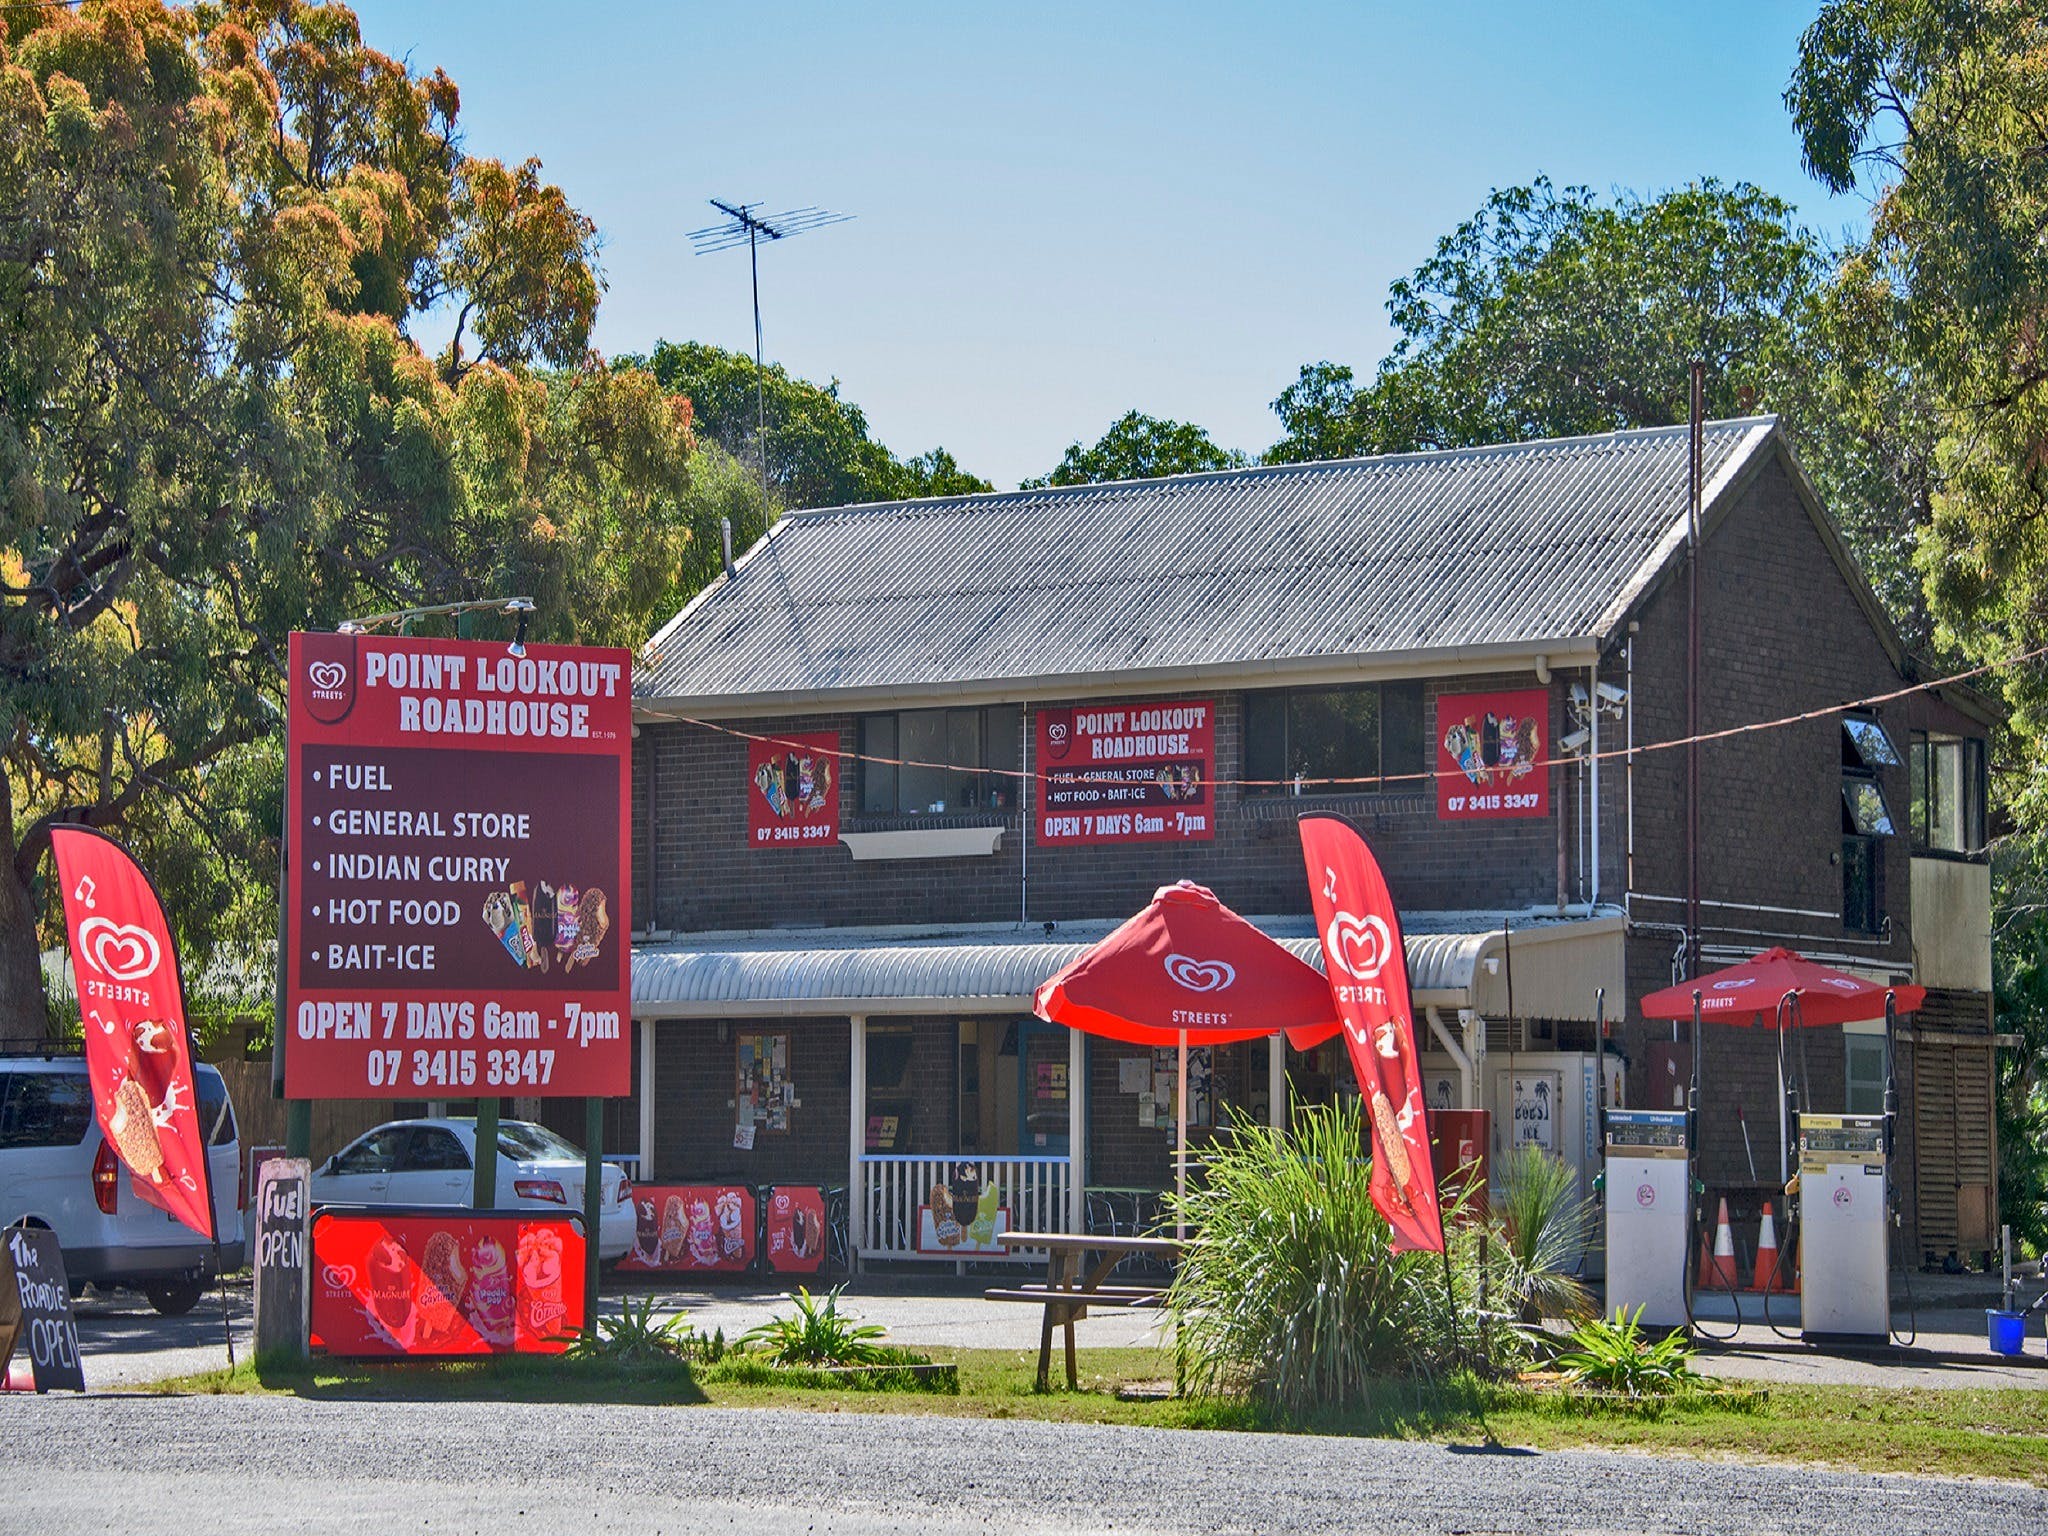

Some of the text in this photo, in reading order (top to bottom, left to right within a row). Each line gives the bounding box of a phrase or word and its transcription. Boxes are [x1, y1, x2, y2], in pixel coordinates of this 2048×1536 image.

[366, 652, 621, 697] POINT LOOKOUT
[312, 690, 343, 700] STREETS
[400, 696, 589, 738] ROADHOUSE
[1076, 707, 1206, 735] POINT LOOKOUT
[1092, 734, 1189, 759] ROADHOUSE
[329, 764, 392, 790] FUEL
[1053, 769, 1155, 784] FUEL GENERAL STORE
[1054, 788, 1145, 802] HOT FOOD BAIT-ICE
[1448, 793, 1538, 811] 07 3415 3347
[329, 809, 530, 839] GENERAL STORE
[757, 825, 830, 840] 07 3415 3347
[1045, 817, 1080, 837] OPEN
[1084, 816, 1093, 835] 7
[1096, 814, 1131, 835] DAYS
[1135, 813, 1164, 833] 6am
[1176, 812, 1206, 836] 7pm
[329, 853, 510, 883] INDIAN CURRY
[329, 899, 460, 926] HOT FOOD
[328, 945, 435, 970] BAIT-ICE
[1702, 997, 1733, 1009] STREETS
[298, 1001, 372, 1040] OPEN
[381, 1002, 398, 1039] 7
[406, 1002, 475, 1040] DAYS
[483, 1002, 540, 1040] 6am
[565, 1003, 619, 1047] 7pm
[1172, 1010, 1227, 1024] STREETS
[368, 1050, 555, 1086] 07 3415 3347
[261, 1230, 303, 1268] OPEN
[325, 1290, 352, 1298] STREETS
[32, 1318, 81, 1369] OPEN
